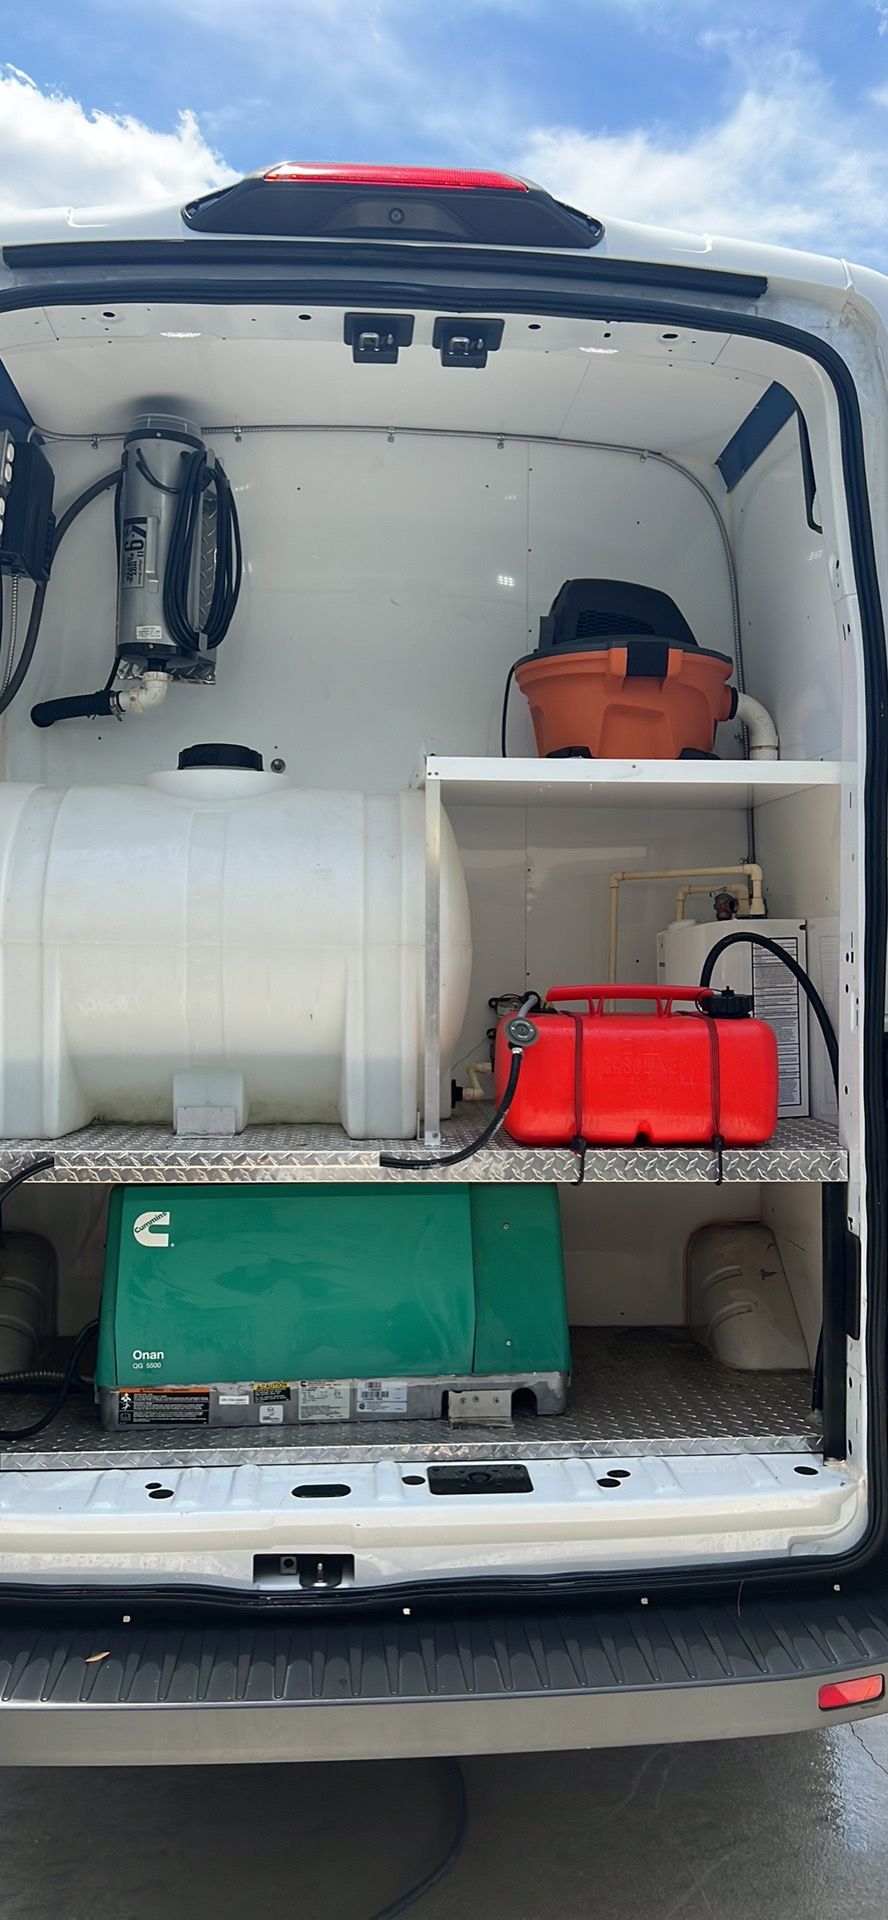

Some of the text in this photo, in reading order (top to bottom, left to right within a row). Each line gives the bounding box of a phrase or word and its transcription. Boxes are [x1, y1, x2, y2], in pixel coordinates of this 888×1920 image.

[134, 1212, 168, 1234] Cummins
[132, 1349, 165, 1361] Onan
[132, 1362, 144, 1370] QG
